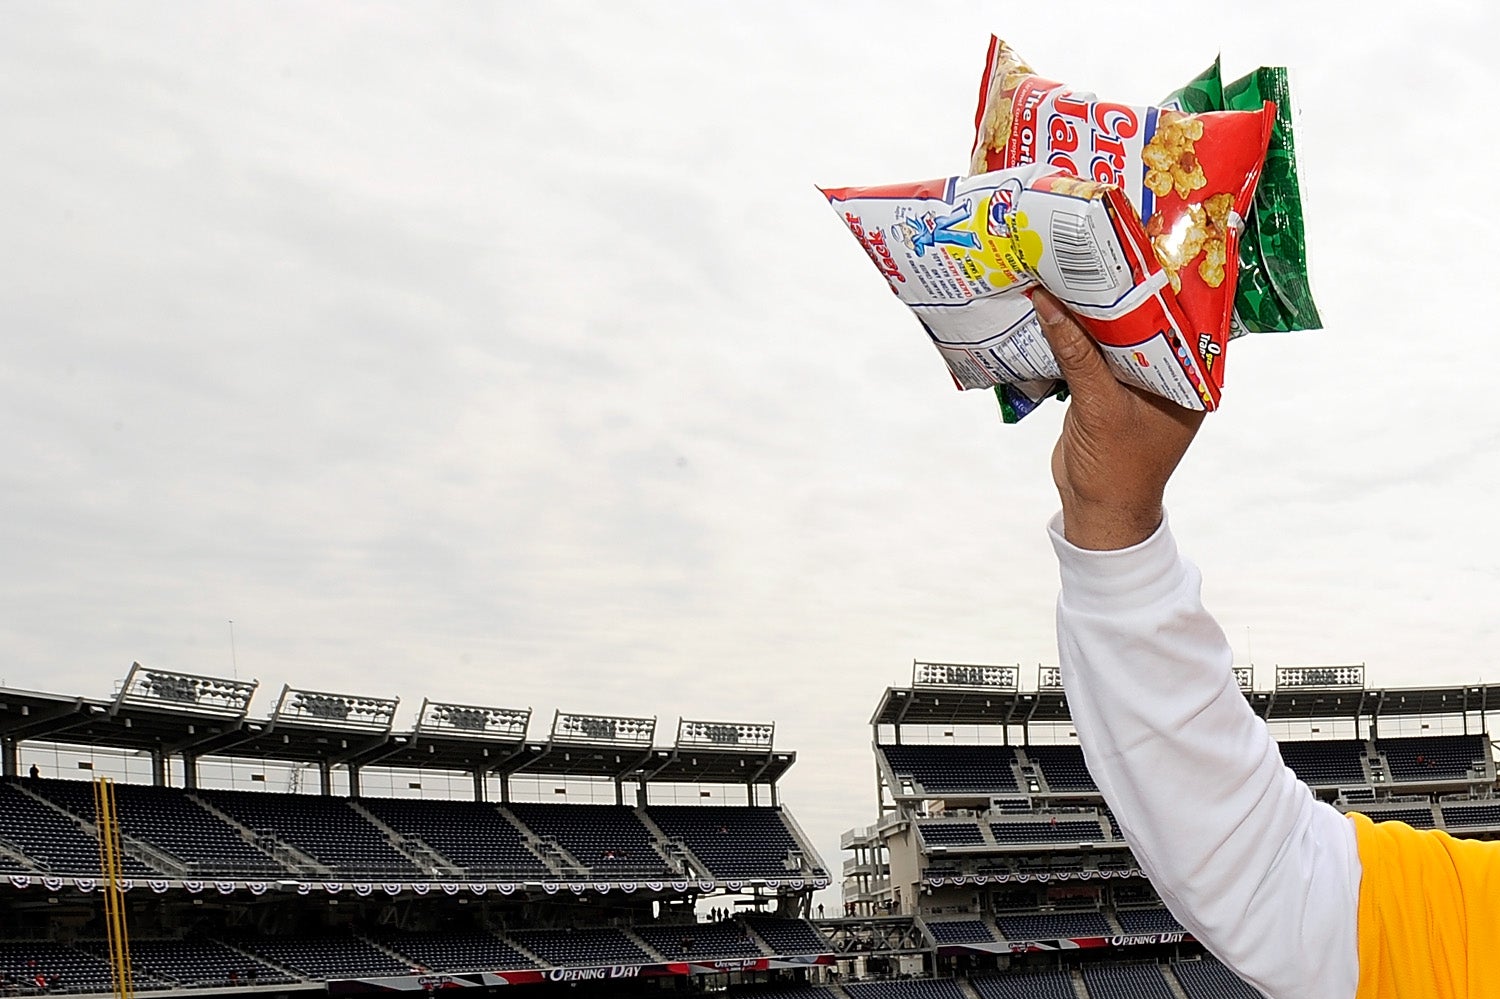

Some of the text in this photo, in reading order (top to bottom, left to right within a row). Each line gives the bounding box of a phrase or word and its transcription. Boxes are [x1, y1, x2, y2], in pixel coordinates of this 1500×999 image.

[1022, 89, 1046, 122] The
[868, 230, 906, 283] Jack
[1208, 343, 1221, 355] 0
[1112, 932, 1184, 946] OPENING DAY
[550, 965, 641, 982] OPENING DAY
